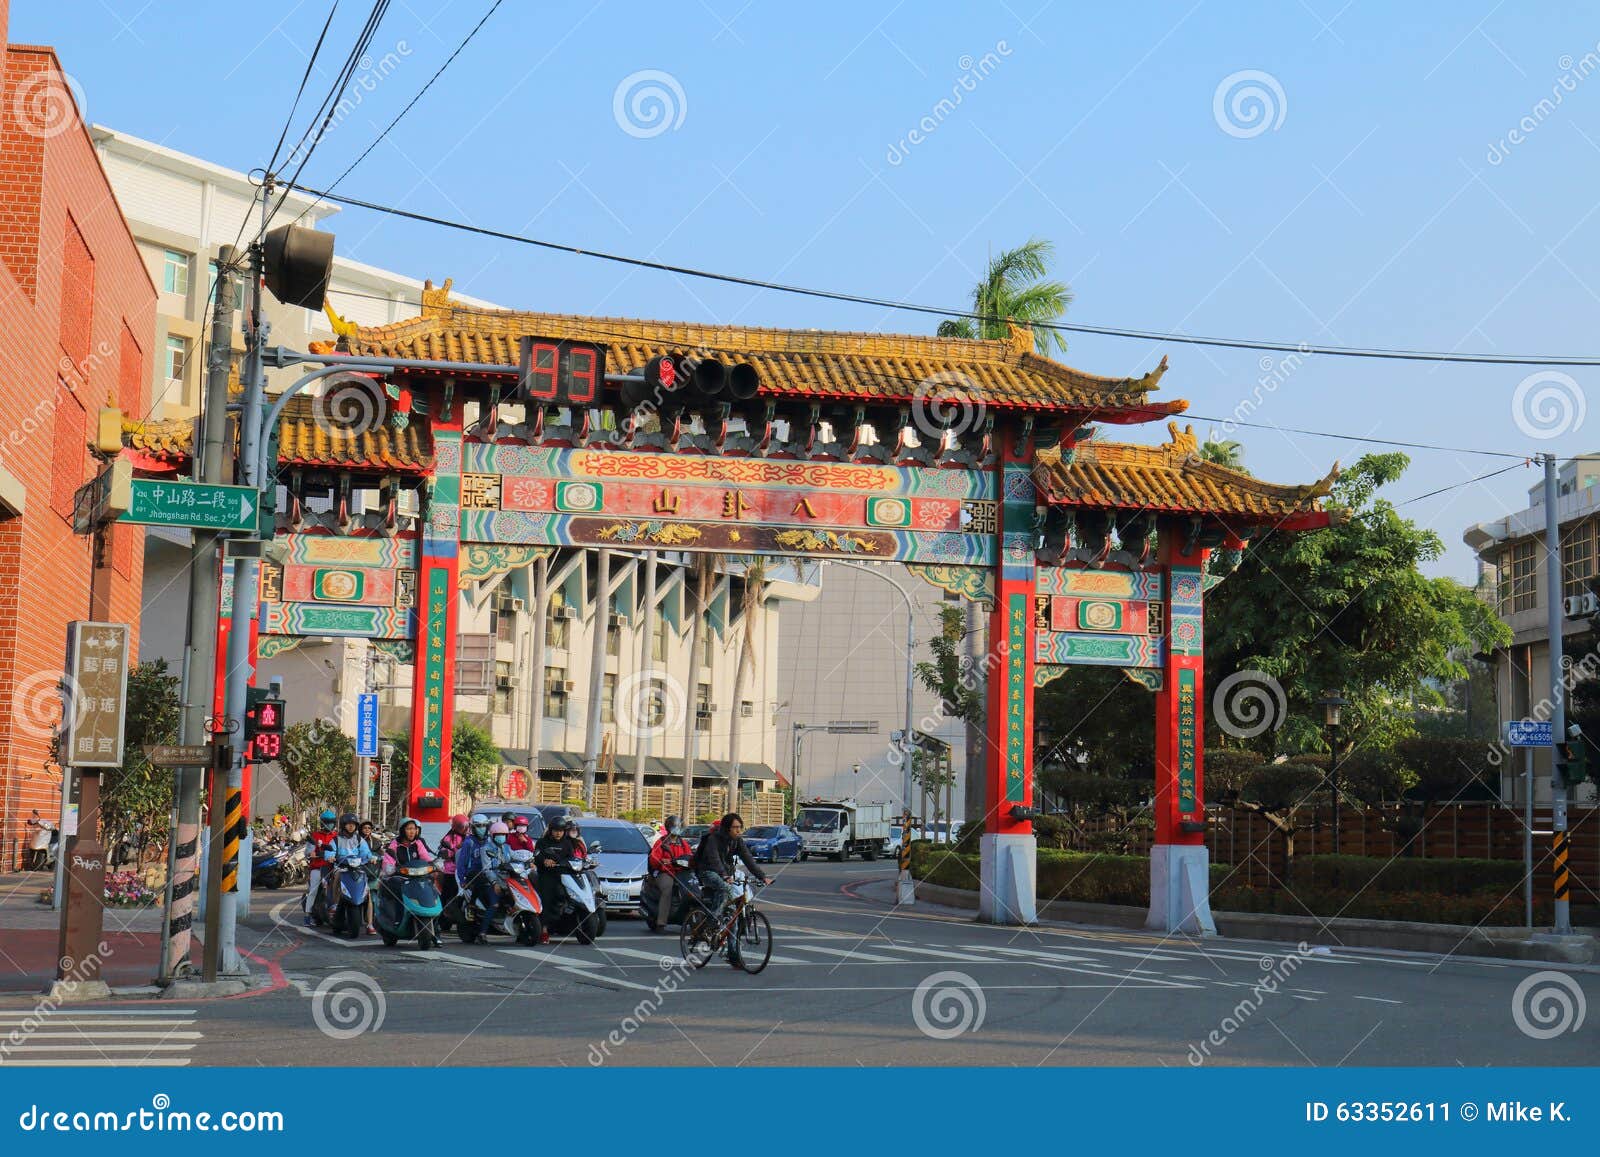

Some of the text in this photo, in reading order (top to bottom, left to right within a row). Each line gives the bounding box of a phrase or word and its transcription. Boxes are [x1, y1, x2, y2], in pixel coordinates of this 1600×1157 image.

[530, 343, 597, 402] 93
[152, 485, 227, 509] 中山路二段
[149, 510, 226, 523] Jhongshan Rd. Sec. 2
[79, 656, 100, 753] 藝術館
[256, 734, 280, 757] 93
